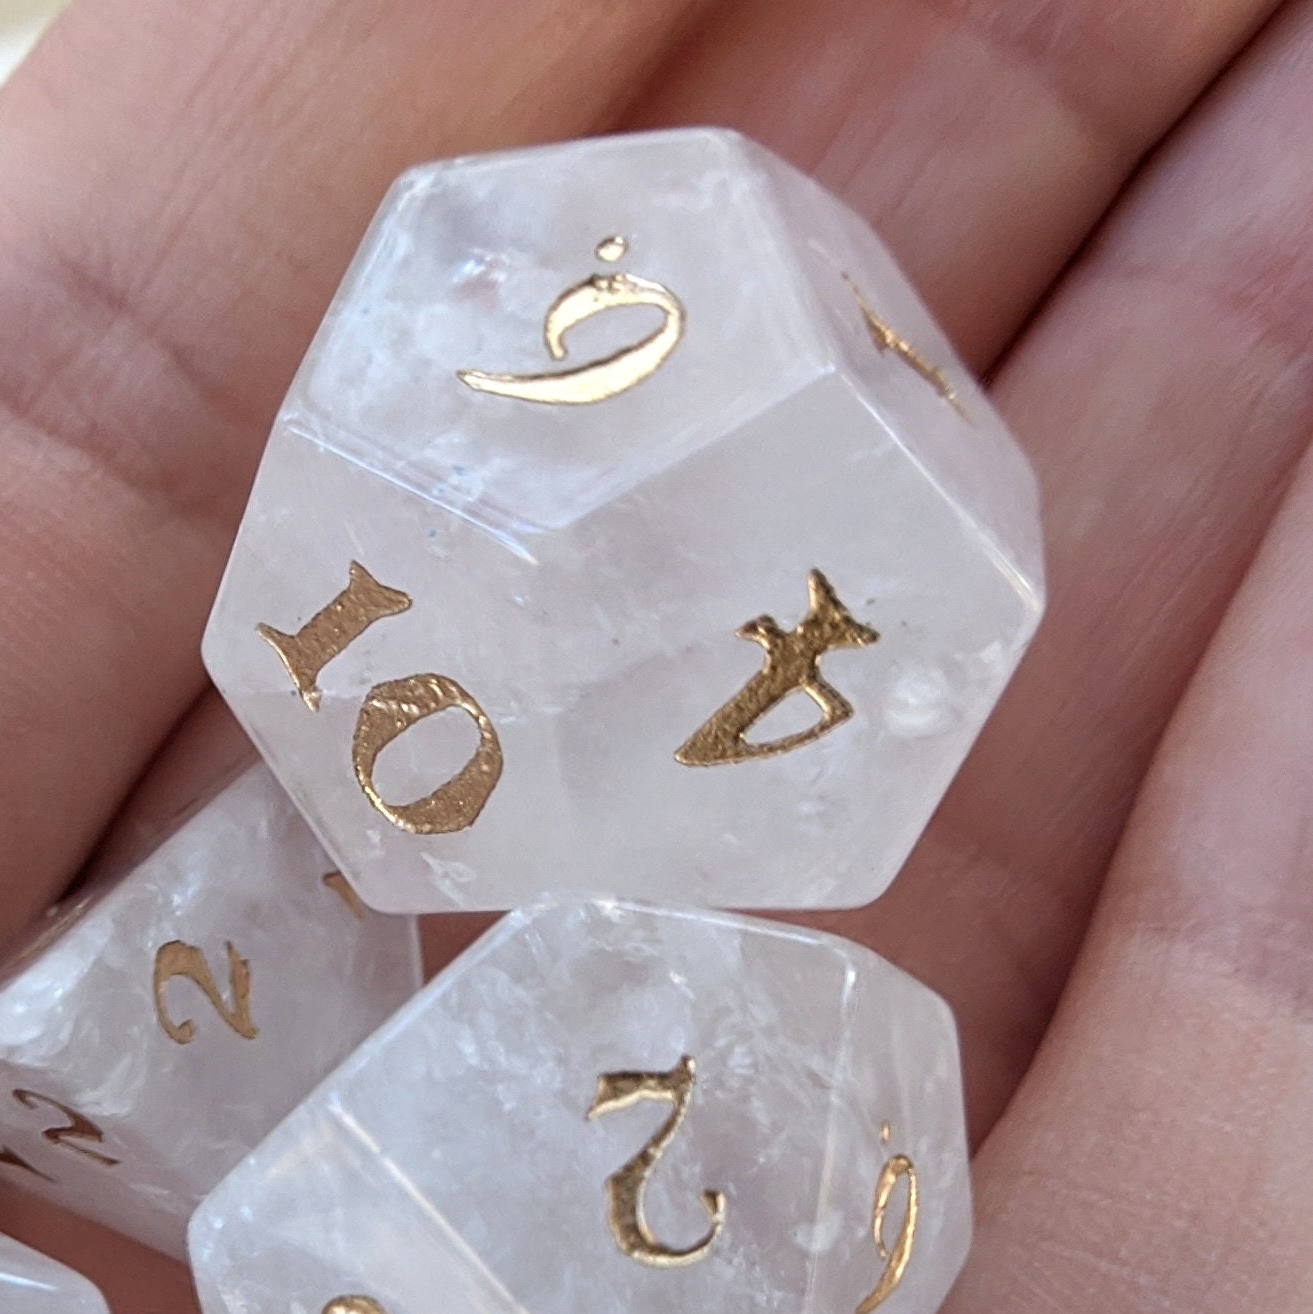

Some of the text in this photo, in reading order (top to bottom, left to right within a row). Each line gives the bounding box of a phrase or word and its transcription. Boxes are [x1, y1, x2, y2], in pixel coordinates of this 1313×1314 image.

[256, 560, 504, 836] 10
[674, 567, 880, 767] 4
[154, 939, 260, 1045] 2
[12, 1088, 122, 1166] 2
